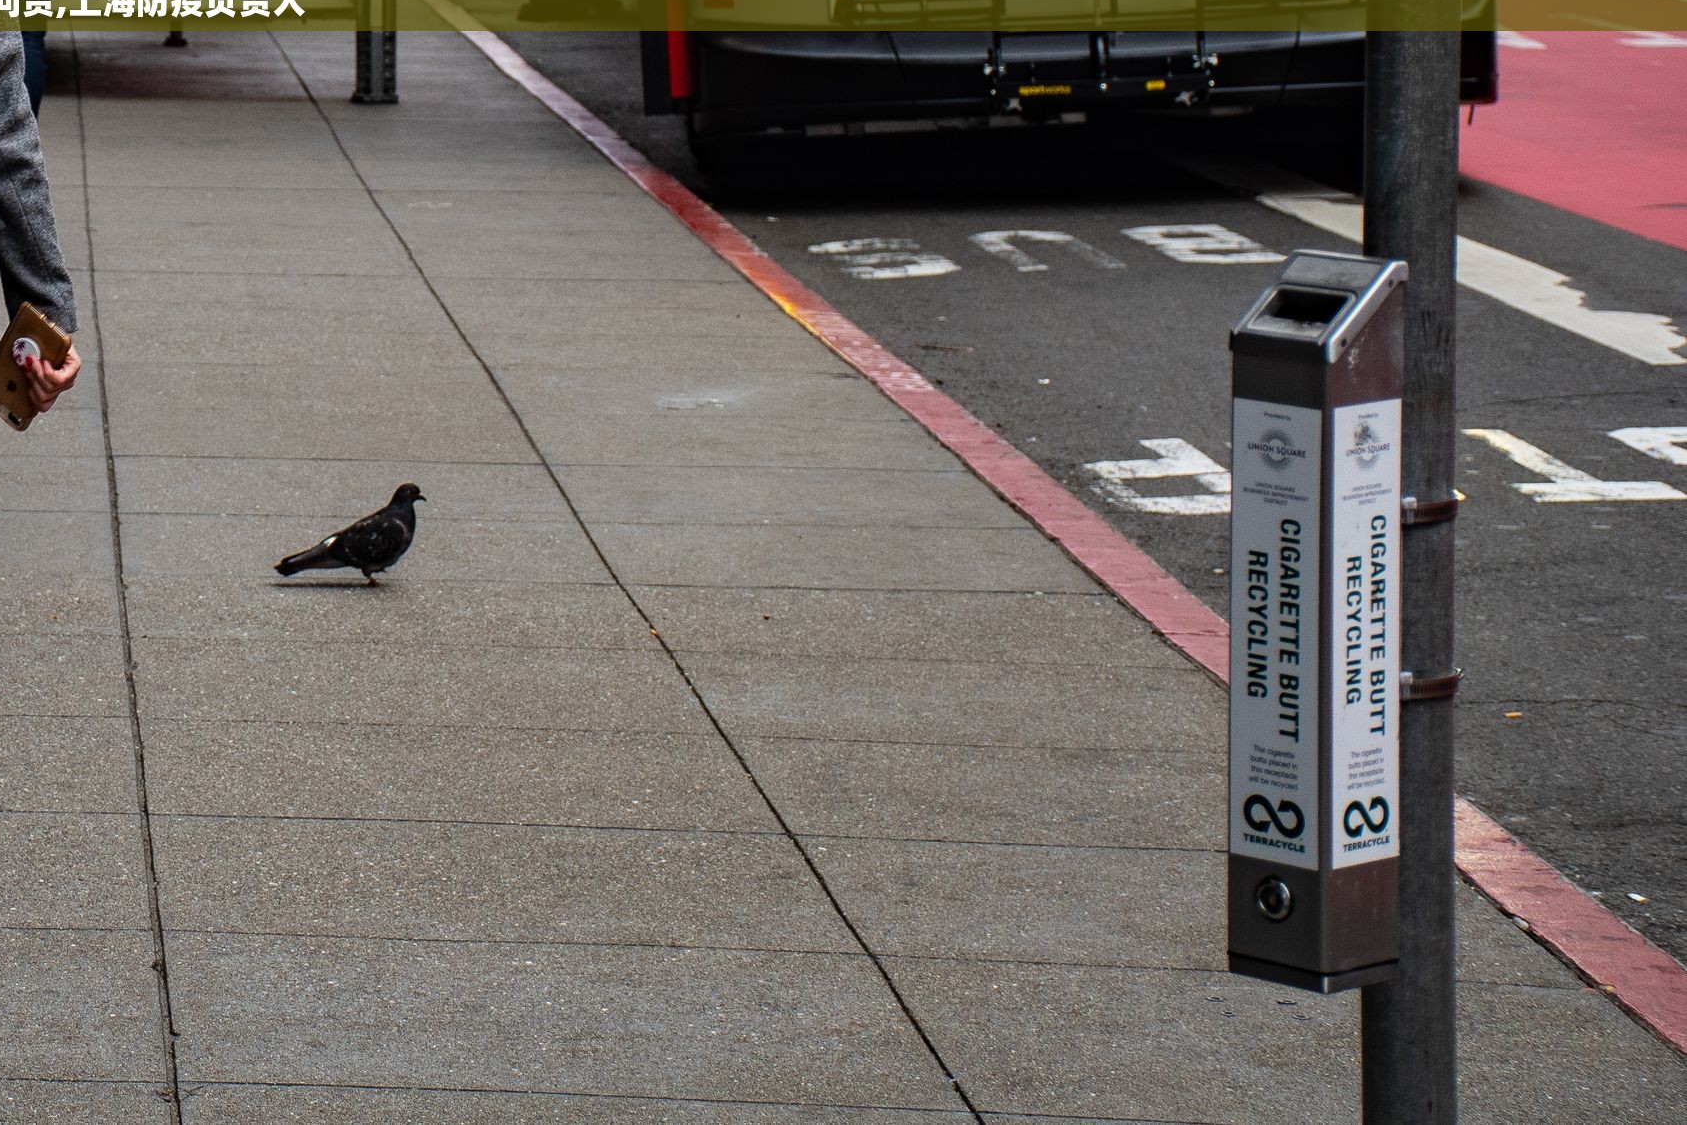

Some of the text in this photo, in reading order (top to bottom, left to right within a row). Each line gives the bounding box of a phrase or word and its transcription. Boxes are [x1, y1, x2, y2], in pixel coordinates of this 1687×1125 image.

[1247, 441, 1307, 458] UNION SQUARE
[1345, 442, 1391, 457] UNION SQUARE
[1247, 549, 1269, 699] RECYCLING
[1278, 518, 1301, 744] CIGARETTE BUTT
[1346, 555, 1363, 706] RECYCLING
[1369, 514, 1387, 737] CIGARETTE BUTT
[1243, 832, 1306, 854] TERRACYCLE
[1343, 835, 1391, 853] TERRACYCLE
